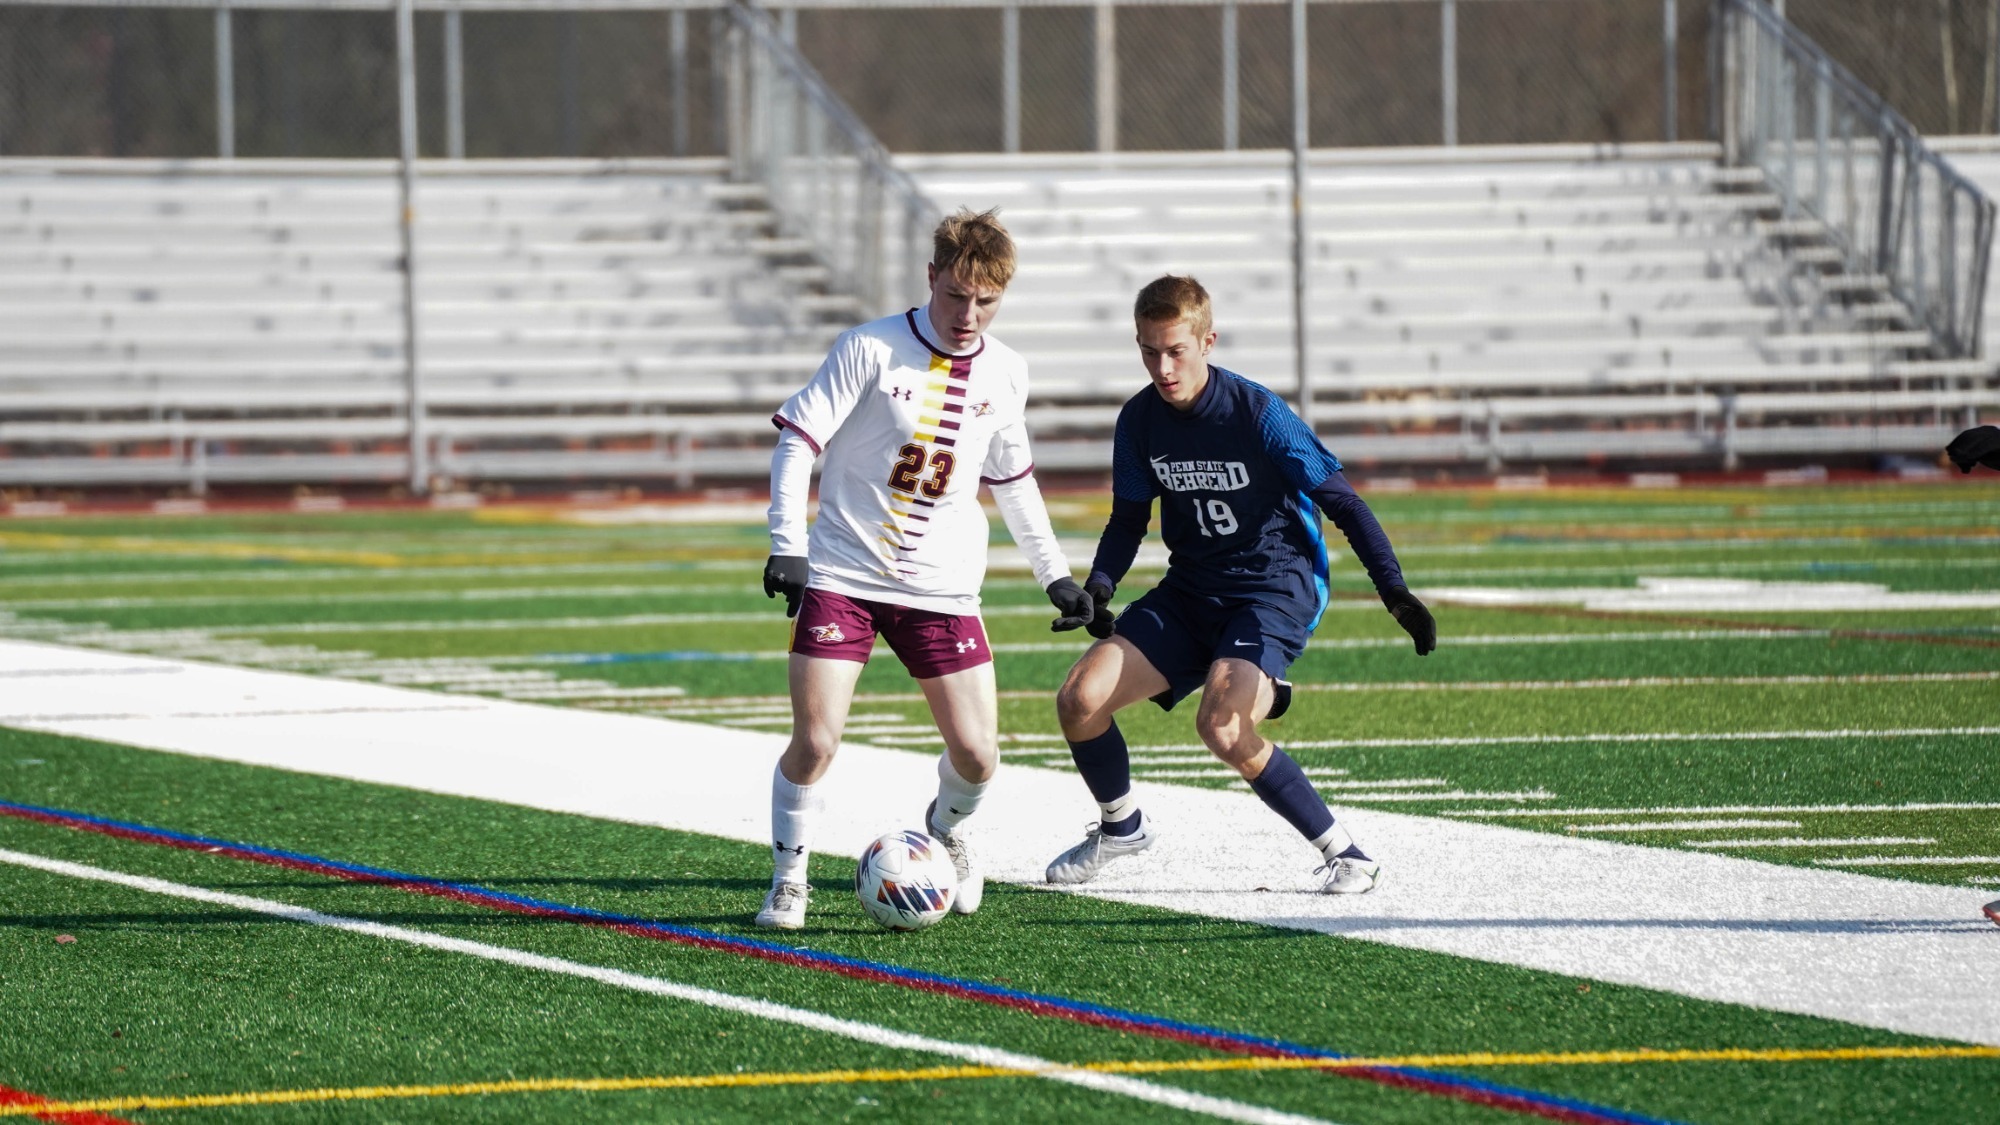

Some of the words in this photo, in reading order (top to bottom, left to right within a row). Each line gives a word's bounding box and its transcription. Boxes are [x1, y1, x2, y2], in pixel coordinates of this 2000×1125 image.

[888, 443, 956, 499] 23
[1151, 461, 1250, 492] BEHREND
[1170, 460, 1195, 473] PENN
[1196, 460, 1224, 472] STATE
[1193, 498, 1239, 537] 19
